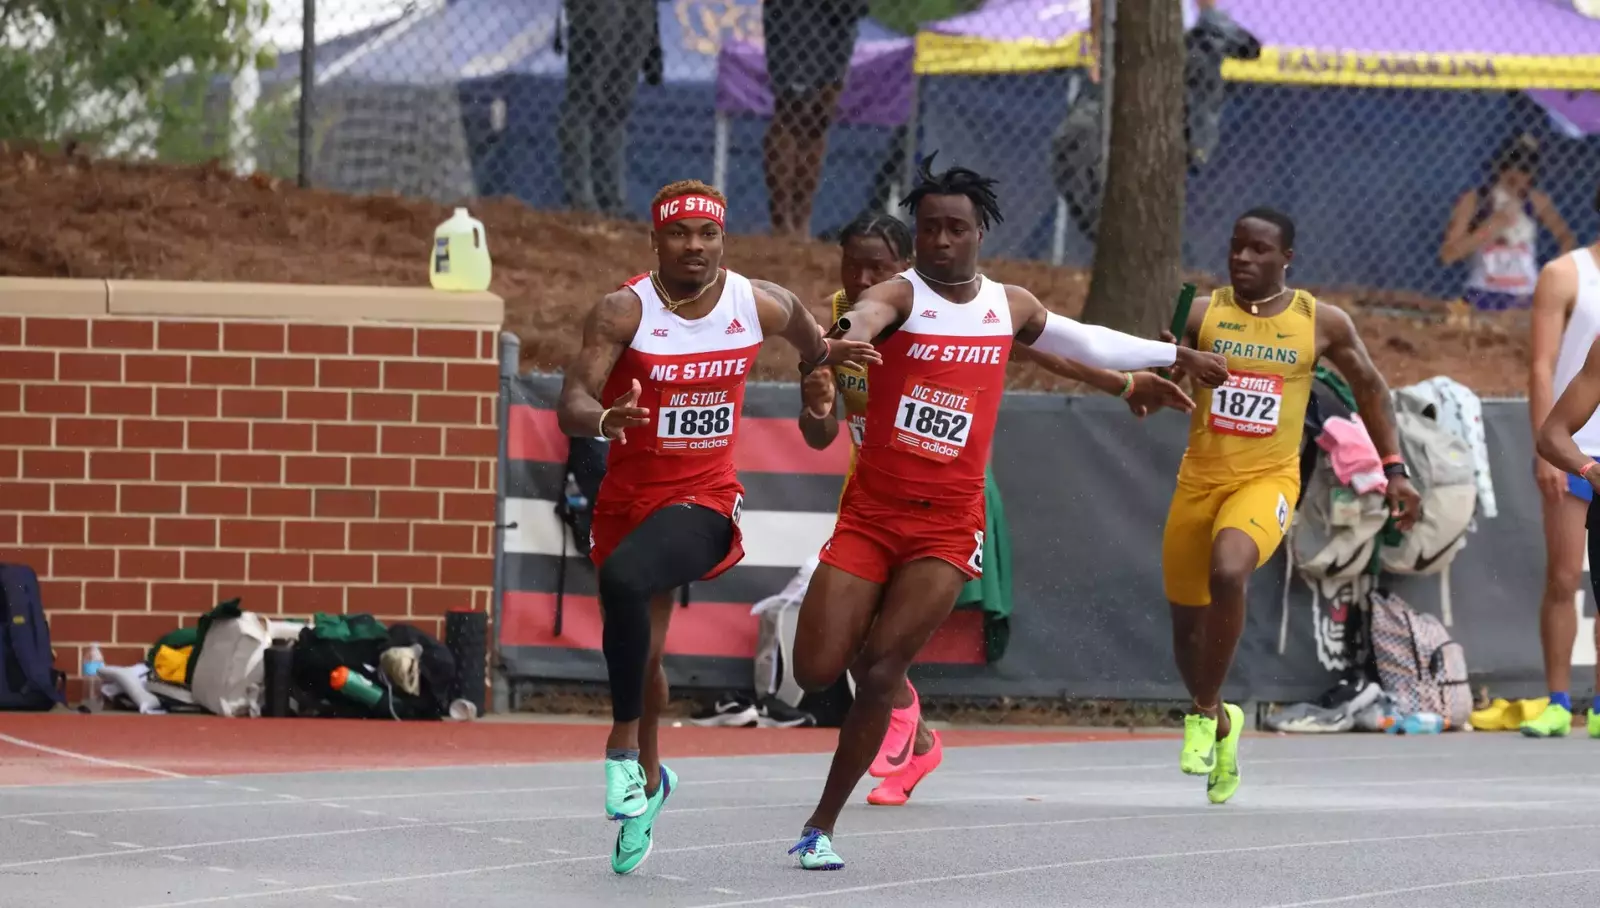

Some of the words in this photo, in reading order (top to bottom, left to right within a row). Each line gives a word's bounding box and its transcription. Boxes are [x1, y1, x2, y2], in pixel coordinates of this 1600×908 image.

[660, 200, 680, 221] NC
[685, 198, 725, 222] STATE
[725, 327, 746, 335] adidas
[982, 317, 1000, 325] adidas
[906, 343, 939, 361] NC
[940, 345, 1002, 365] STATE
[1212, 339, 1298, 365] SPARTANS
[649, 364, 679, 382] NC
[682, 357, 748, 380] STATE
[1239, 377, 1276, 393] STATE
[669, 393, 688, 406] NC
[690, 390, 728, 406] STATE
[910, 384, 931, 400] NC
[931, 389, 969, 411] STATE
[1217, 389, 1276, 421] 1872
[664, 406, 730, 436] 1838
[903, 402, 967, 443] 1852
[689, 437, 728, 450] adidas
[921, 440, 959, 458] adidas
